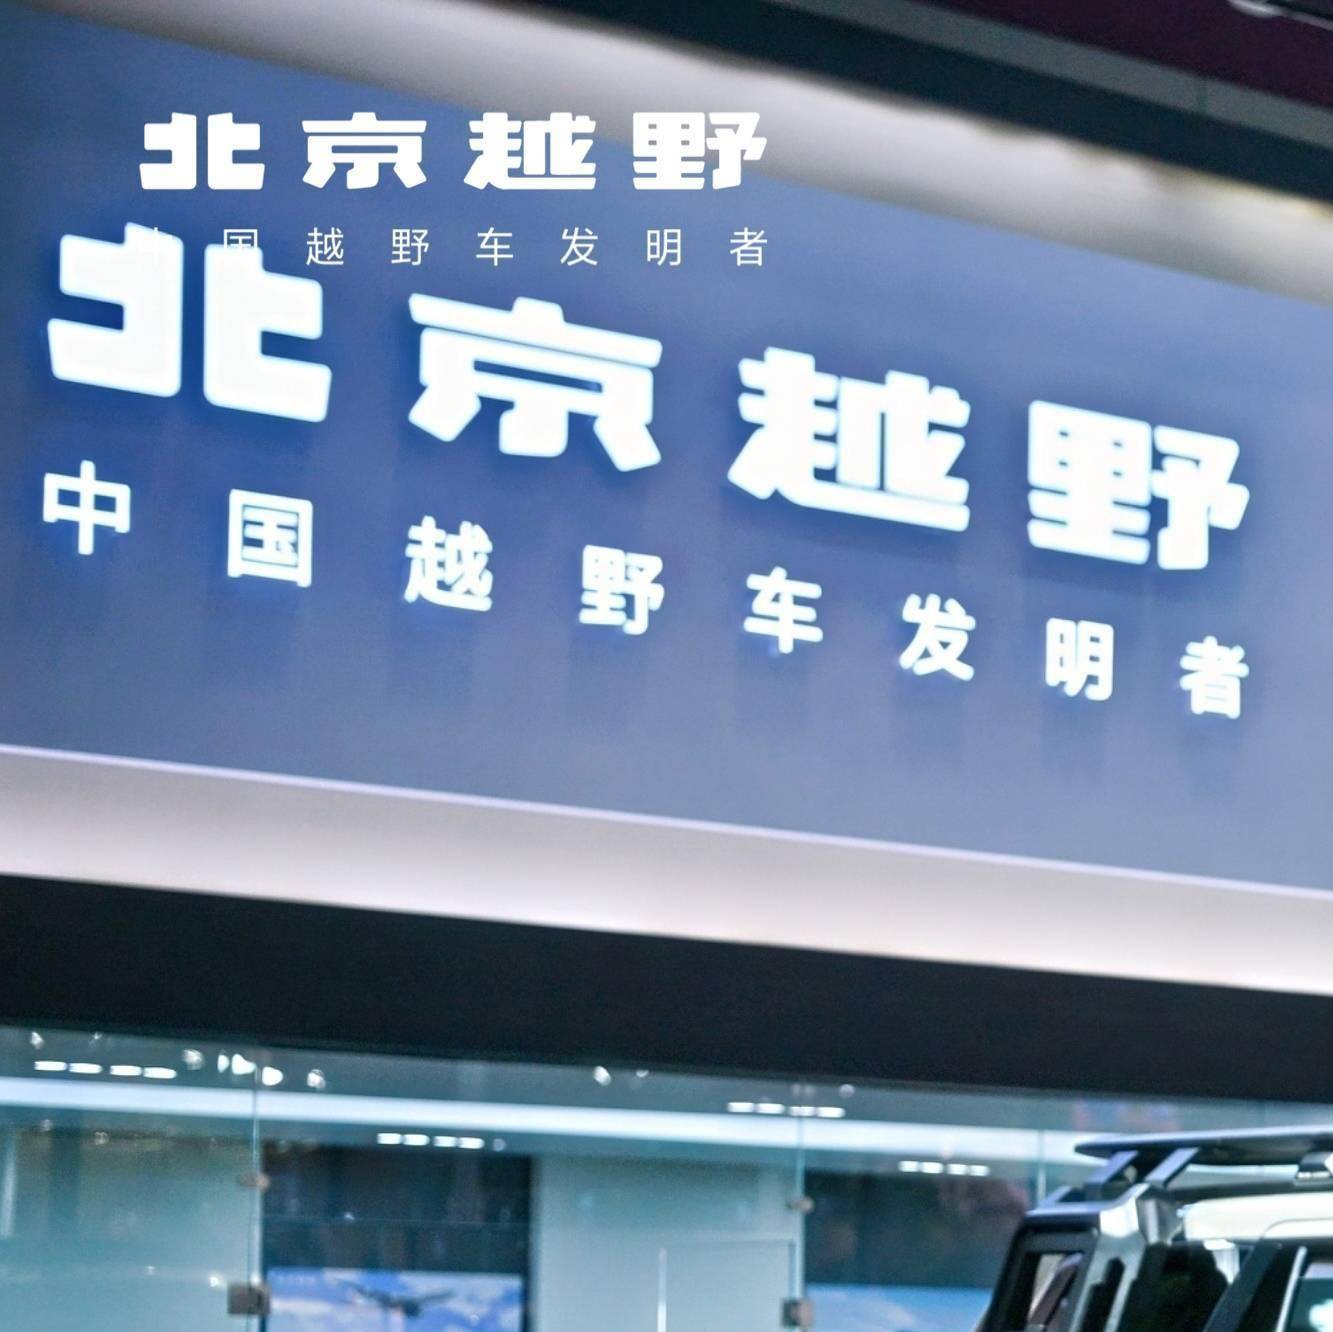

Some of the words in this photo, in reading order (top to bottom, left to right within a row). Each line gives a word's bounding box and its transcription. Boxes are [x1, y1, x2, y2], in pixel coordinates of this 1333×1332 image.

[47, 222, 1250, 571] 北京越野
[42, 460, 1250, 719] 中国越野车发明者
